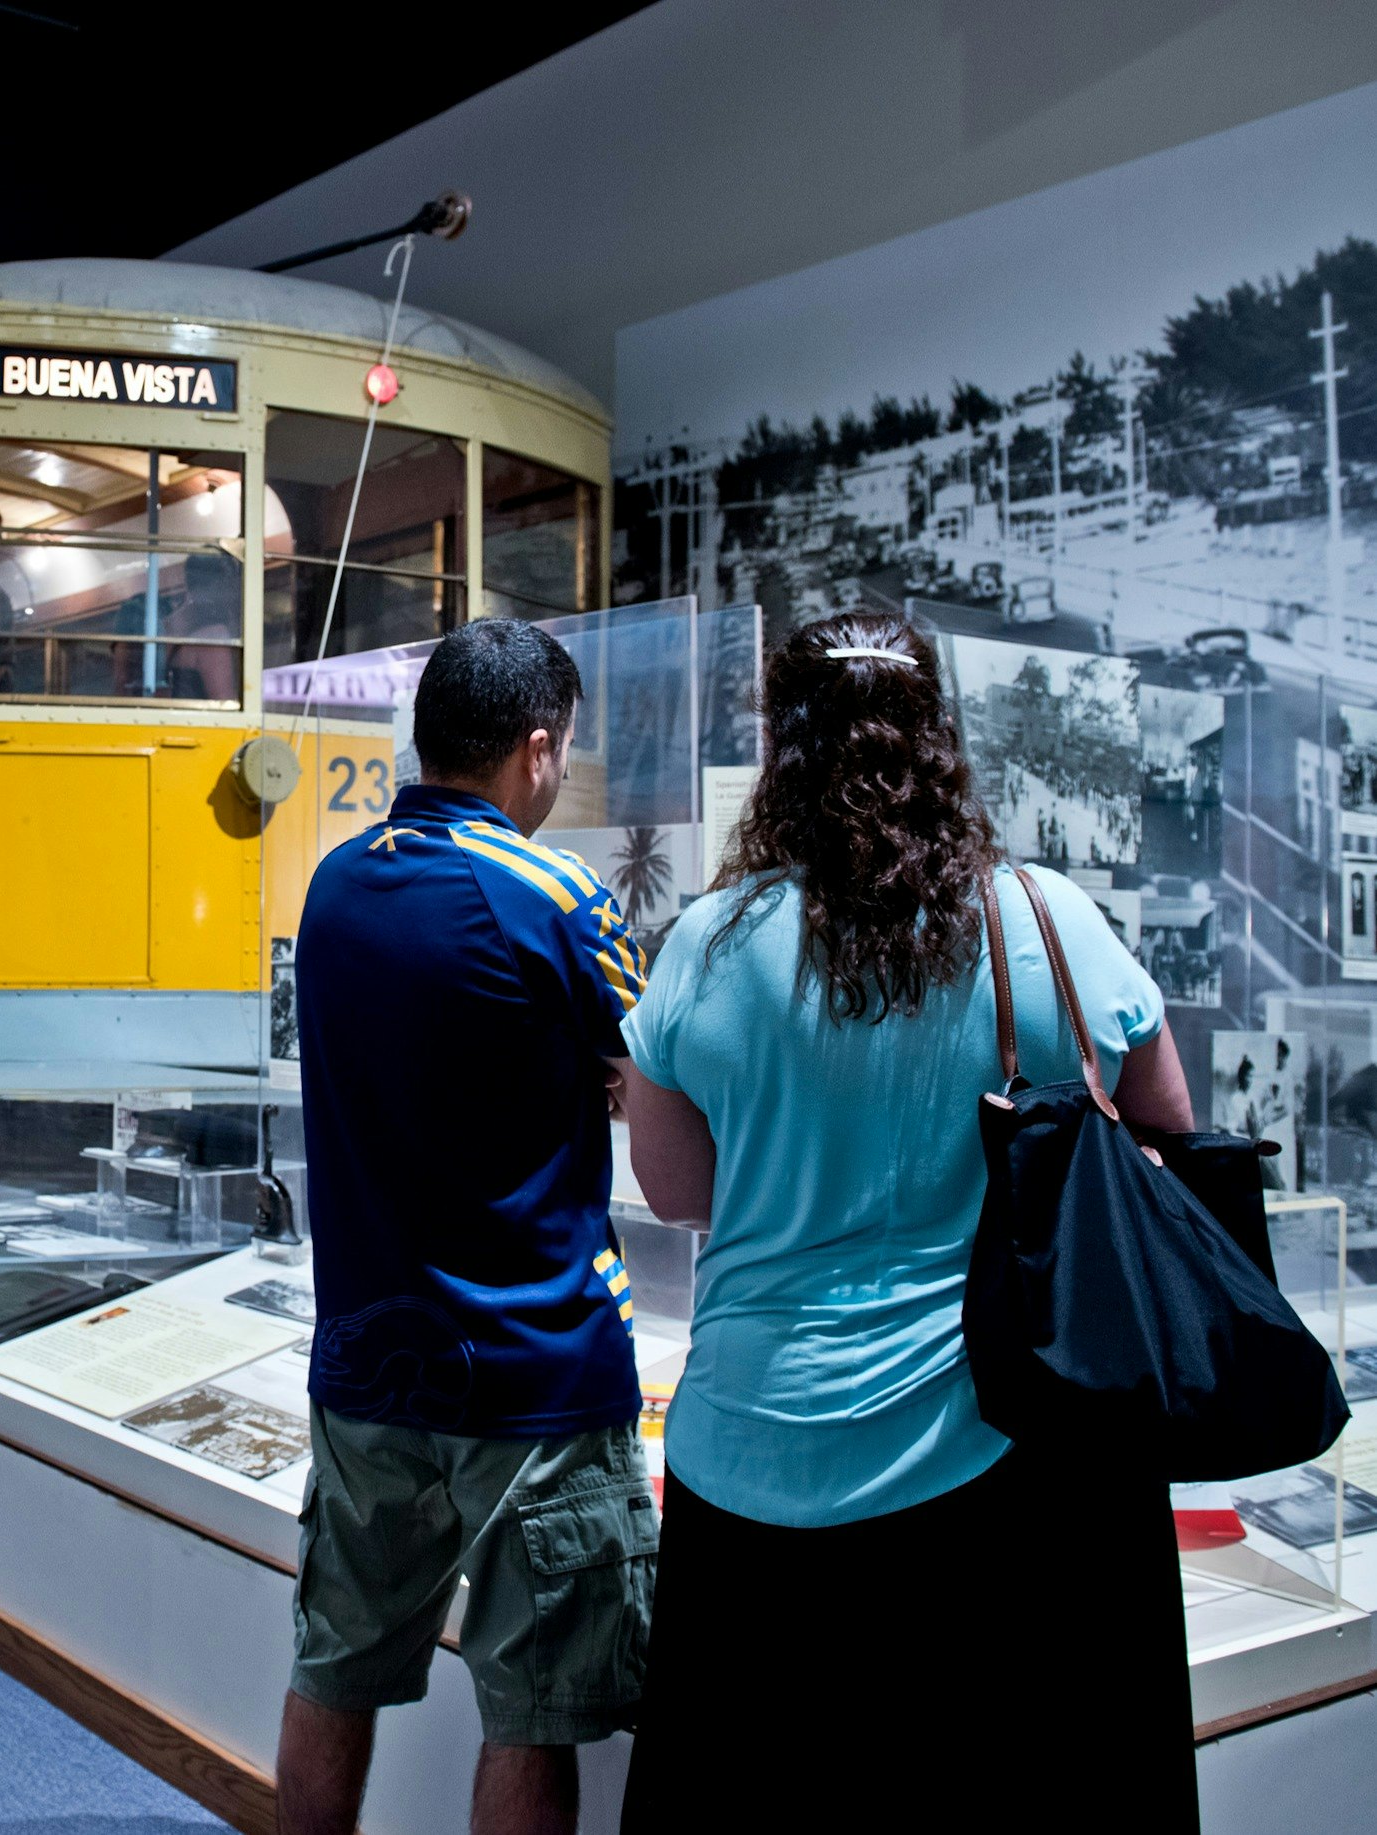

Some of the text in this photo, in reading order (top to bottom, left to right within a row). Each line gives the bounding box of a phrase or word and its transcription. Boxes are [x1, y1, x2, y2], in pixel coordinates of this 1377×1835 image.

[3, 356, 217, 405] BUENA VISTA
[328, 756, 390, 814] 23
